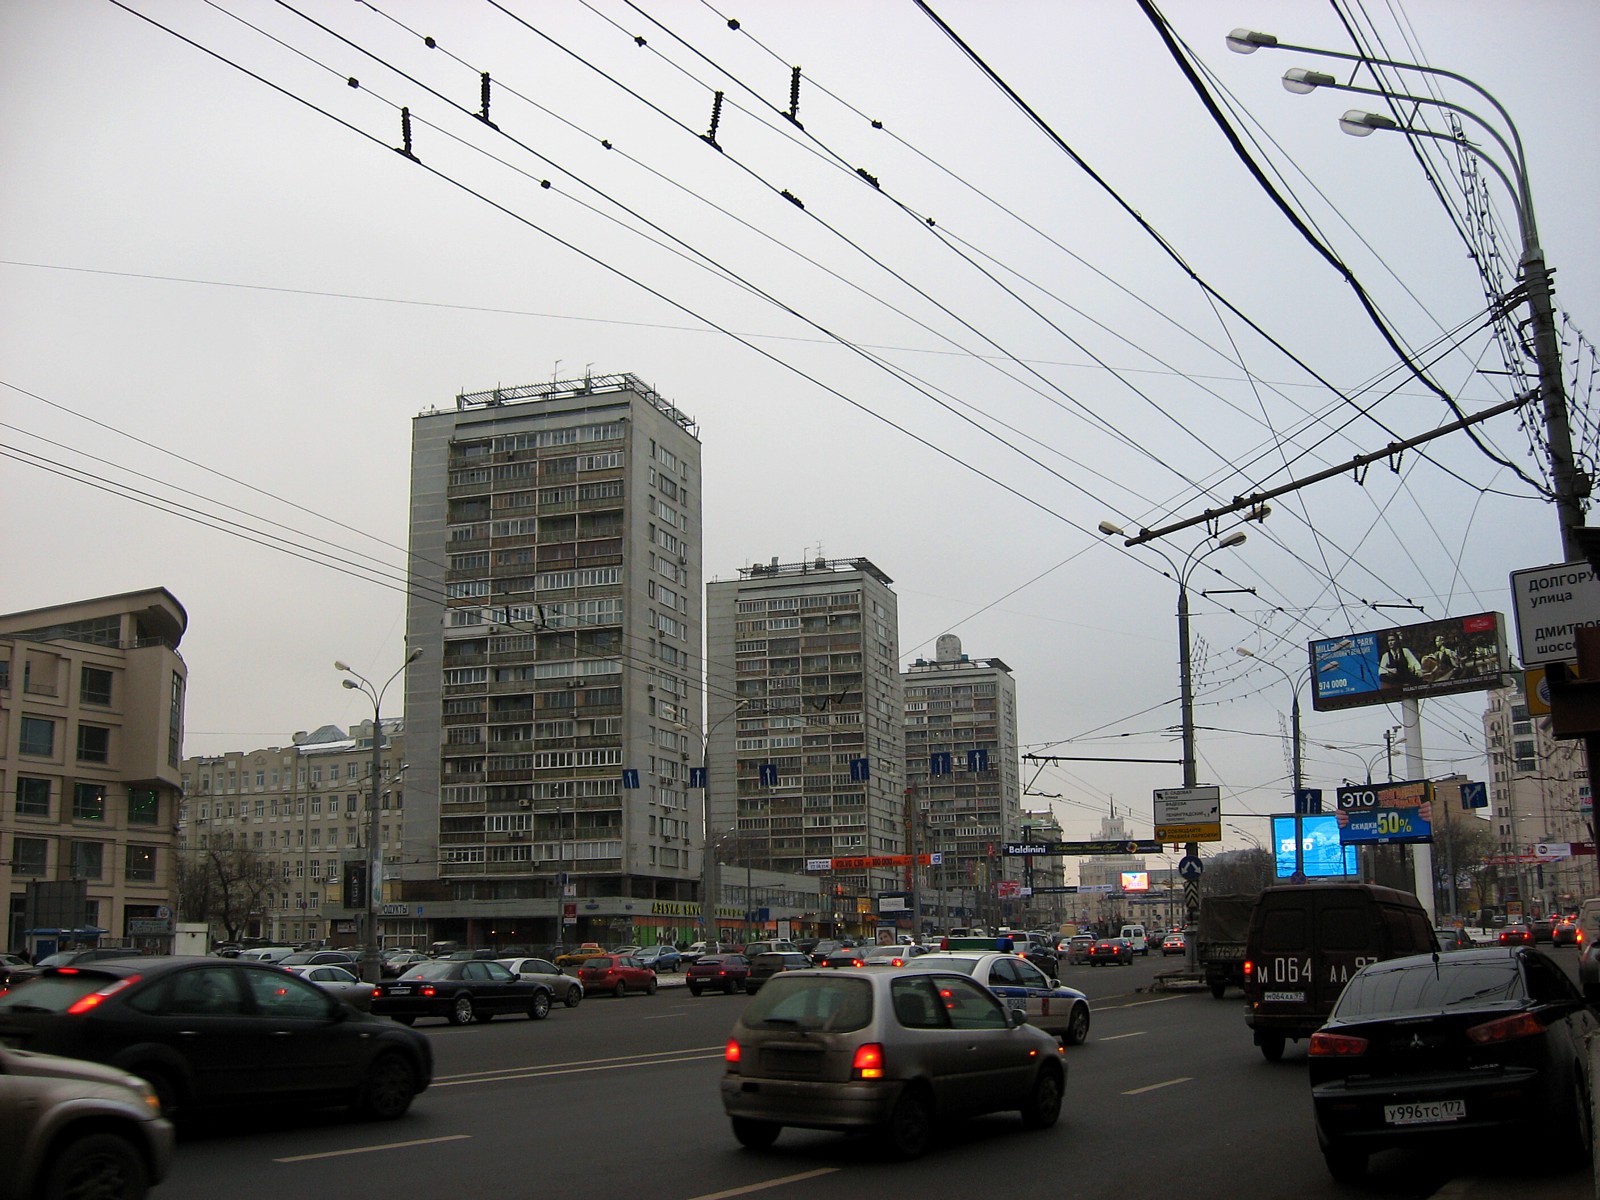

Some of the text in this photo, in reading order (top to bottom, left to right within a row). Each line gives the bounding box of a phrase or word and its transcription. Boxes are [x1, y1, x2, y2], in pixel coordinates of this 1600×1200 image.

[1528, 571, 1596, 593] ДОЛГОРУ
[1530, 591, 1573, 609] улица
[1537, 641, 1578, 655] шосс
[1318, 679, 1347, 690] 974 0000
[1342, 791, 1375, 808] ЭТО
[1009, 845, 1046, 854] Baldinini
[383, 904, 408, 914] ОДУКТЫ
[652, 902, 680, 915] АЗБУКА
[684, 903, 702, 916] ВКУС
[1257, 966, 1268, 984] М
[1274, 957, 1312, 983] 064
[1330, 965, 1348, 983] АА
